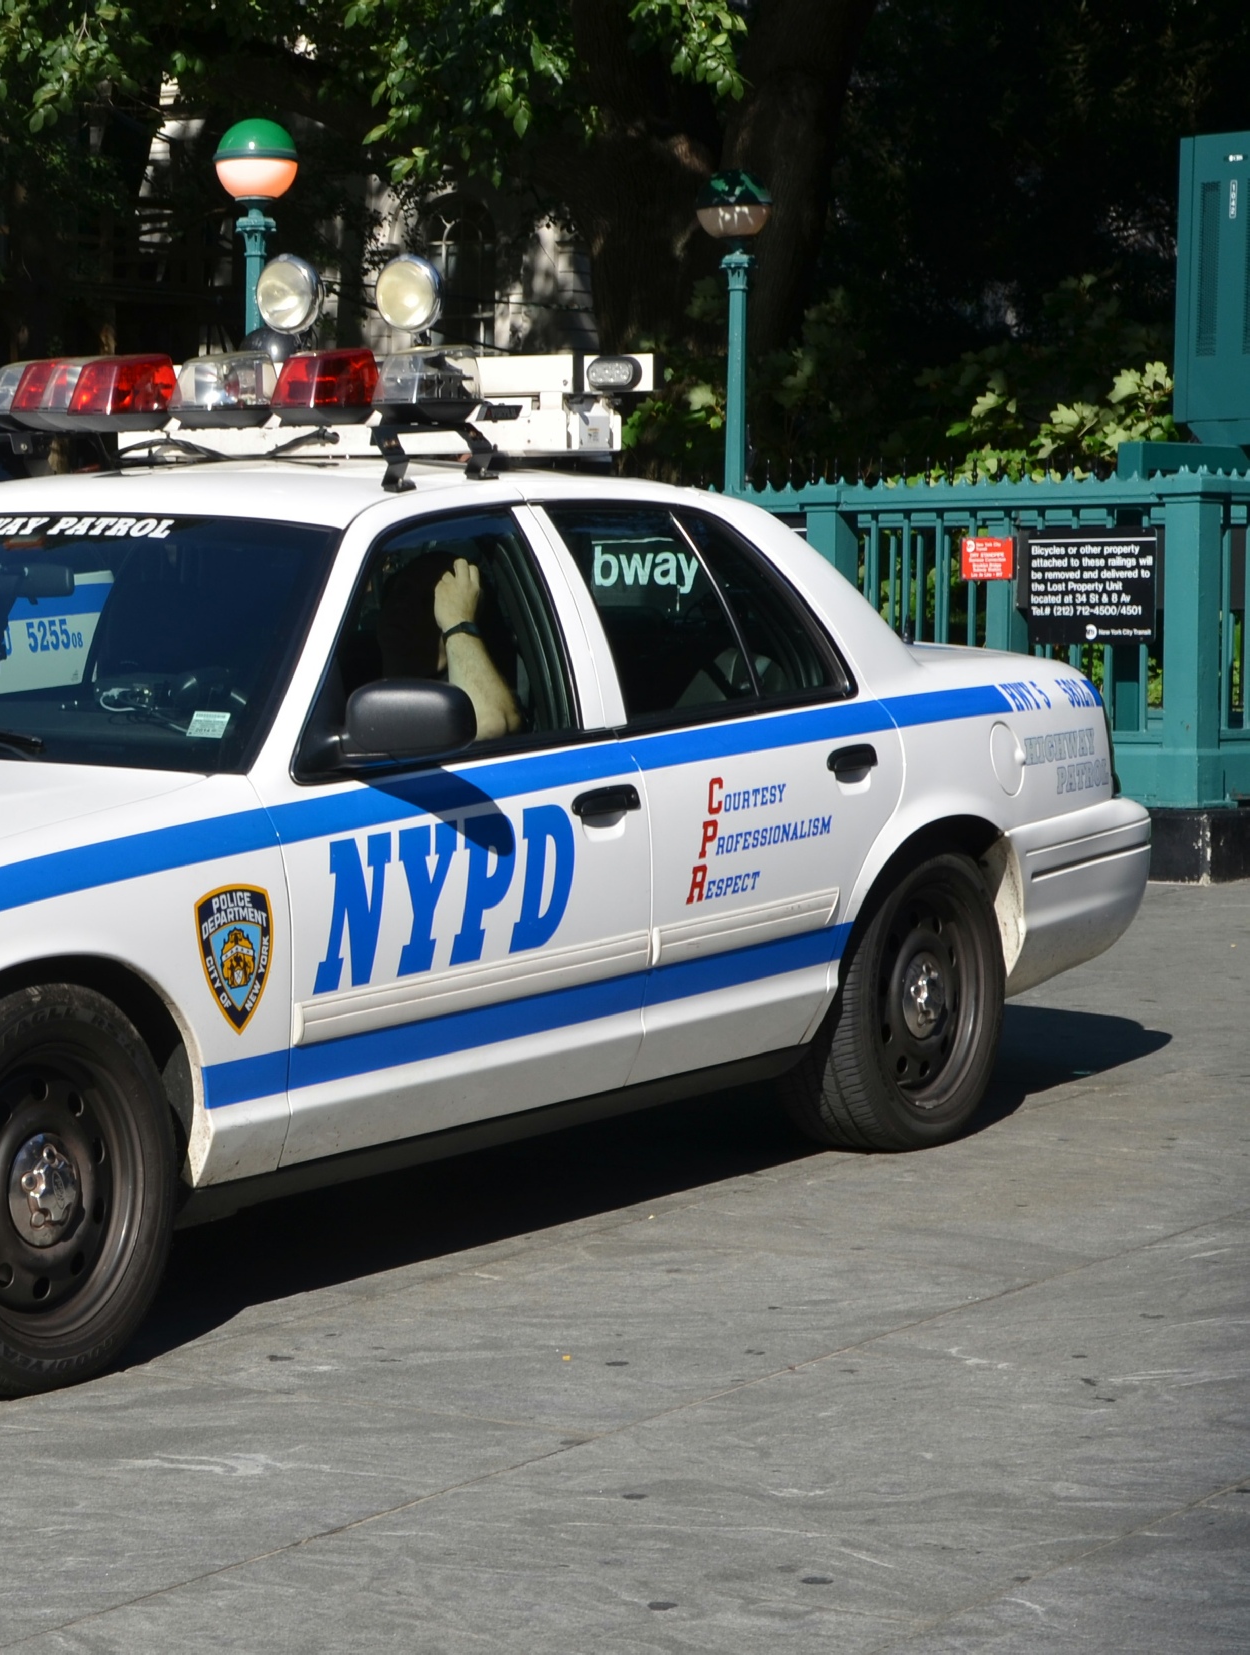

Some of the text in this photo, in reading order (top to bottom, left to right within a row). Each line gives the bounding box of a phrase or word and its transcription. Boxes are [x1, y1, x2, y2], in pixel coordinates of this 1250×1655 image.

[46, 517, 175, 539] PATROL
[1031, 544, 1140, 556] Bicycles or other property
[1031, 555, 1153, 568] attached to these railings will
[594, 545, 699, 594] bway
[1031, 568, 1151, 580] be removed and delivered to
[1031, 581, 1123, 592] the Lost Property Unit
[1030, 593, 1062, 604] located
[1063, 594, 1073, 604] at
[1075, 593, 1087, 603] 34
[1089, 593, 1099, 603] St
[1101, 593, 1109, 603] &
[1120, 593, 1131, 603] Av
[1052, 605, 1074, 617] (212)
[1076, 605, 1142, 616] 712-4500/4501
[26, 618, 71, 653] 5255
[71, 632, 83, 649] 08
[1024, 727, 1095, 766] HIGHWAY
[1056, 758, 1110, 795] PATROL
[707, 777, 787, 815] COURTESY
[698, 815, 833, 859] PROFESSIONALISM
[312, 804, 576, 996] NYPD
[685, 864, 761, 905] RESPECT
[211, 891, 253, 914] POLICE
[201, 907, 267, 940] DEPARTMENT
[205, 934, 270, 1012] CITY OF NEW YORK
